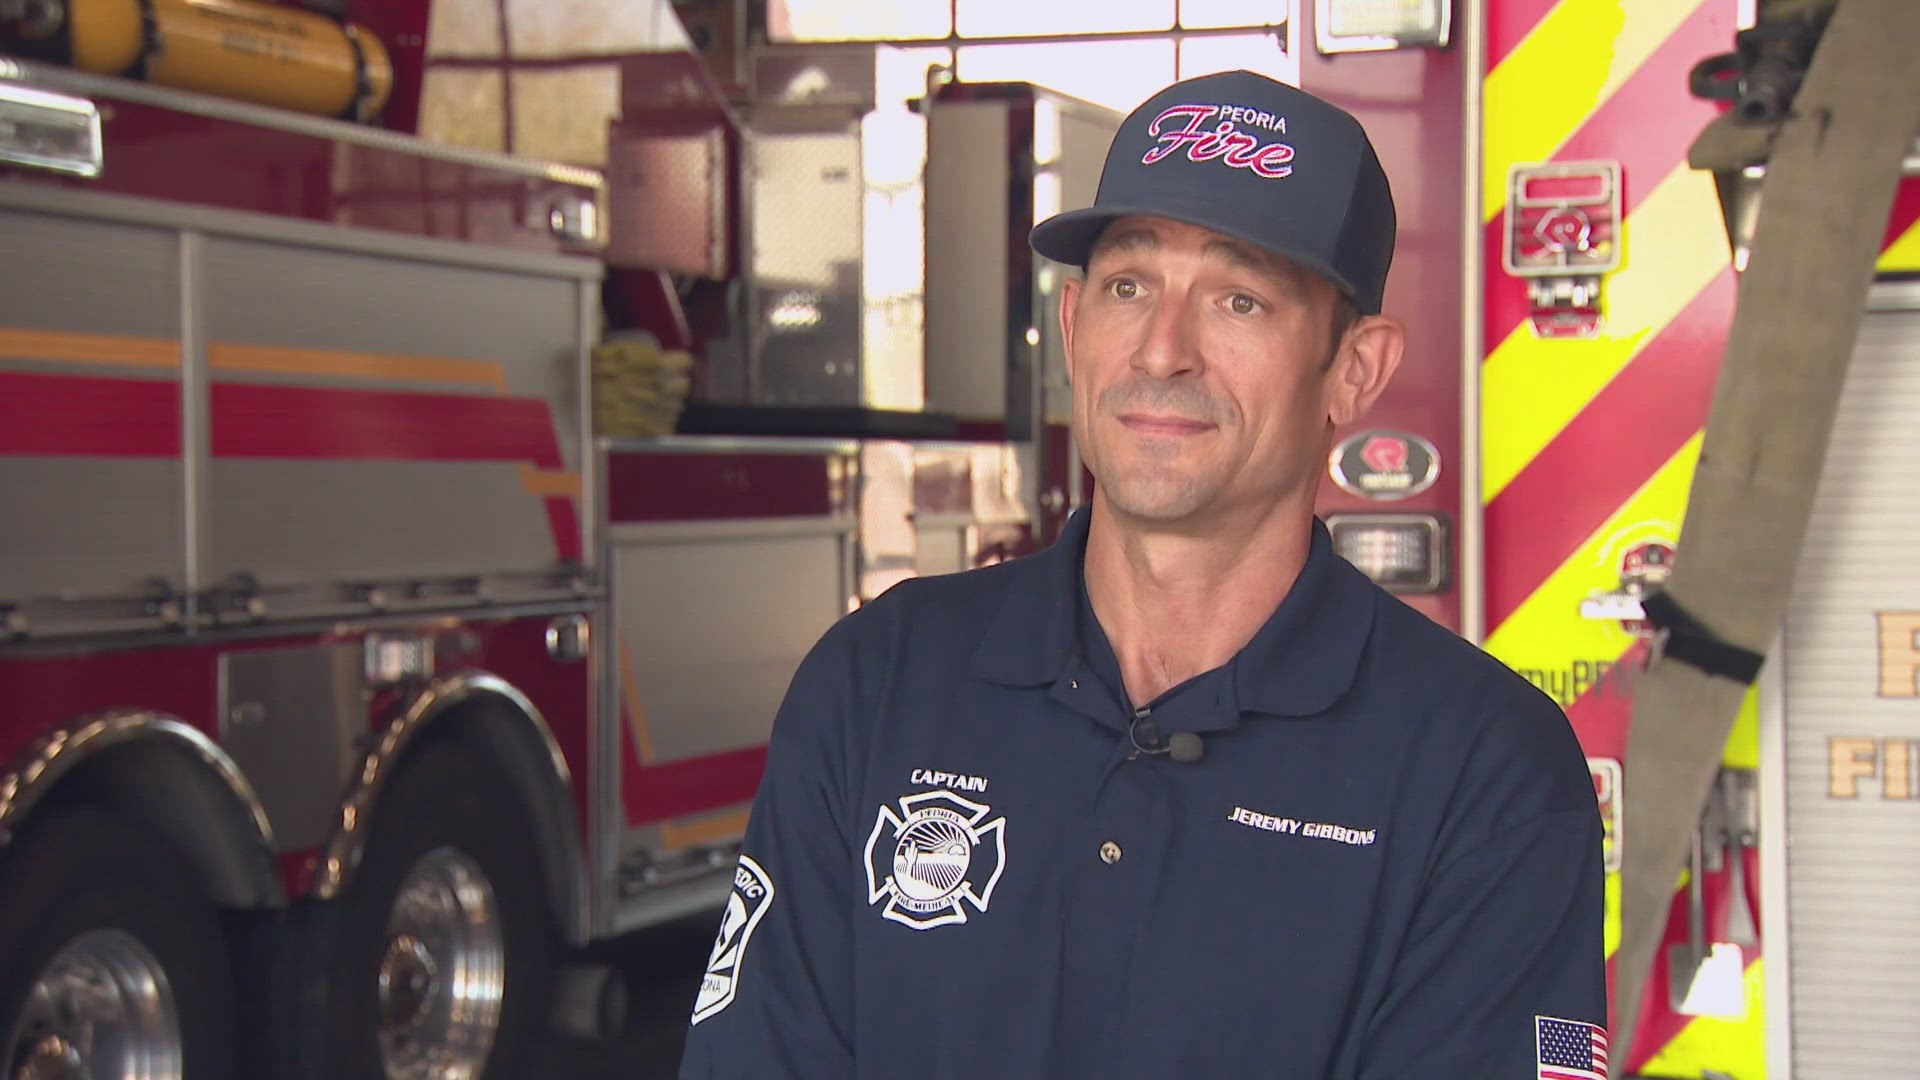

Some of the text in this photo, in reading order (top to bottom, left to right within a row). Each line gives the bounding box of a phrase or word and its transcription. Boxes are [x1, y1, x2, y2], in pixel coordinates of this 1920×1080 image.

[1218, 105, 1287, 134] PEORIA
[1141, 103, 1296, 179] Fire
[910, 768, 989, 793] CAPTAIN
[1826, 735, 1920, 800] FI
[1227, 806, 1377, 846] JEREMY GIBBONS
